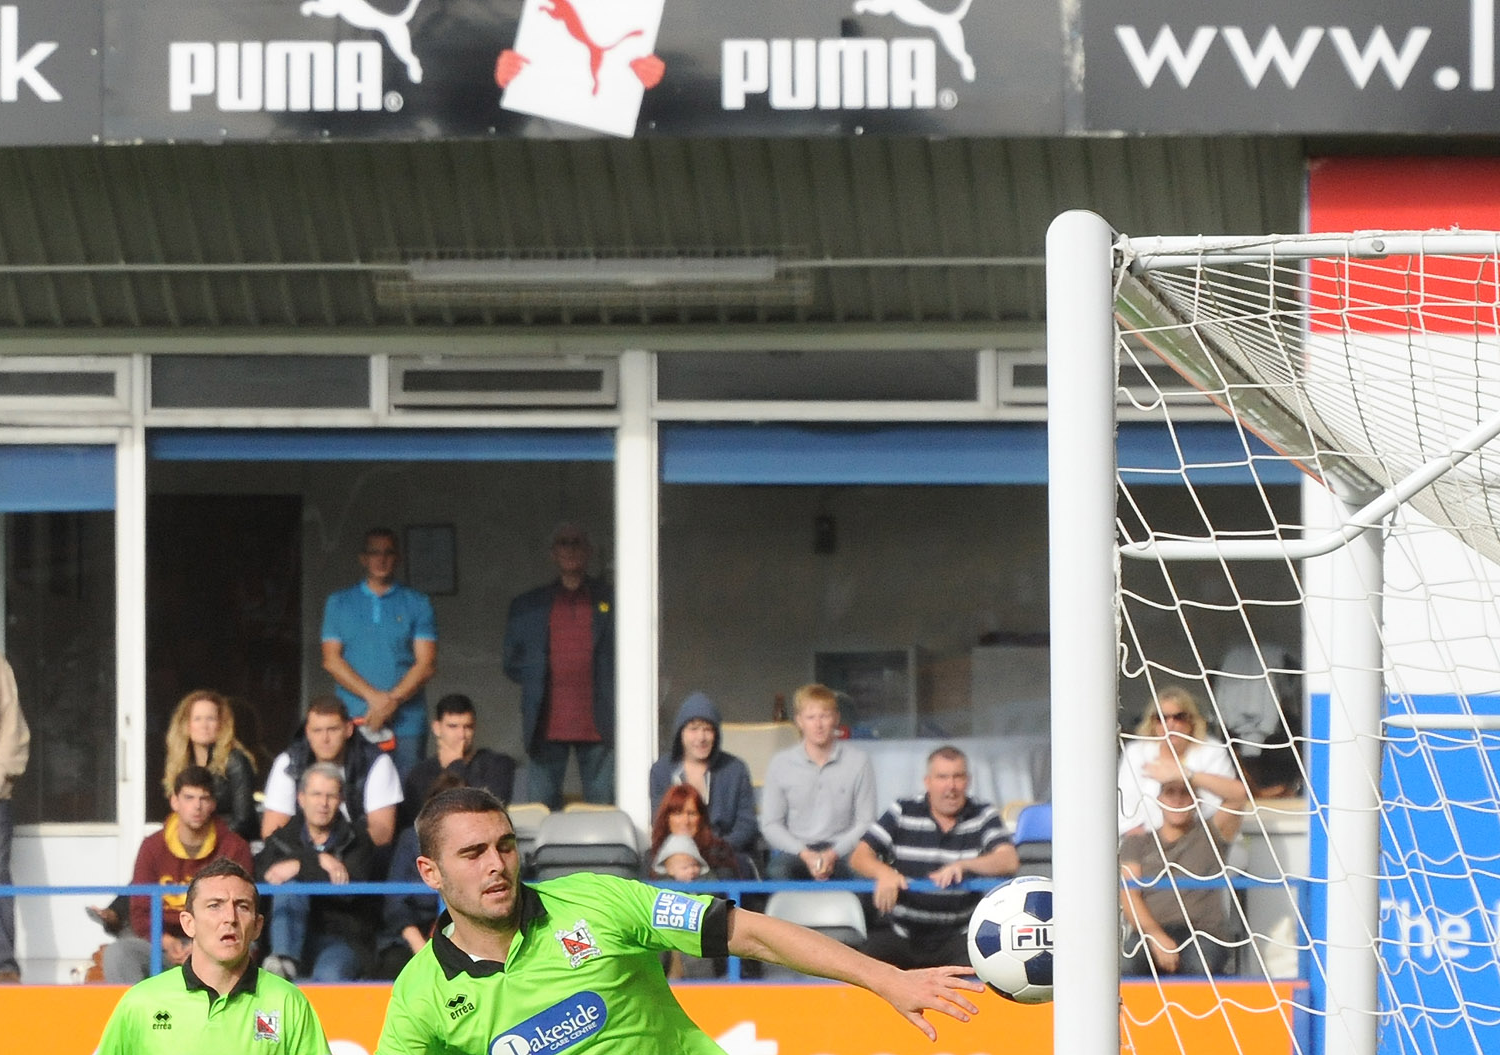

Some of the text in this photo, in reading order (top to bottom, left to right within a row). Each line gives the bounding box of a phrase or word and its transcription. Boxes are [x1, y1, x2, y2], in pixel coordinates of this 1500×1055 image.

[169, 41, 384, 112] PUMA
[721, 39, 937, 110] PUMA
[656, 893, 676, 925] BLUE
[669, 903, 687, 928] SQ
[1017, 927, 1053, 947] FIL
[549, 1037, 570, 1051] CARE
